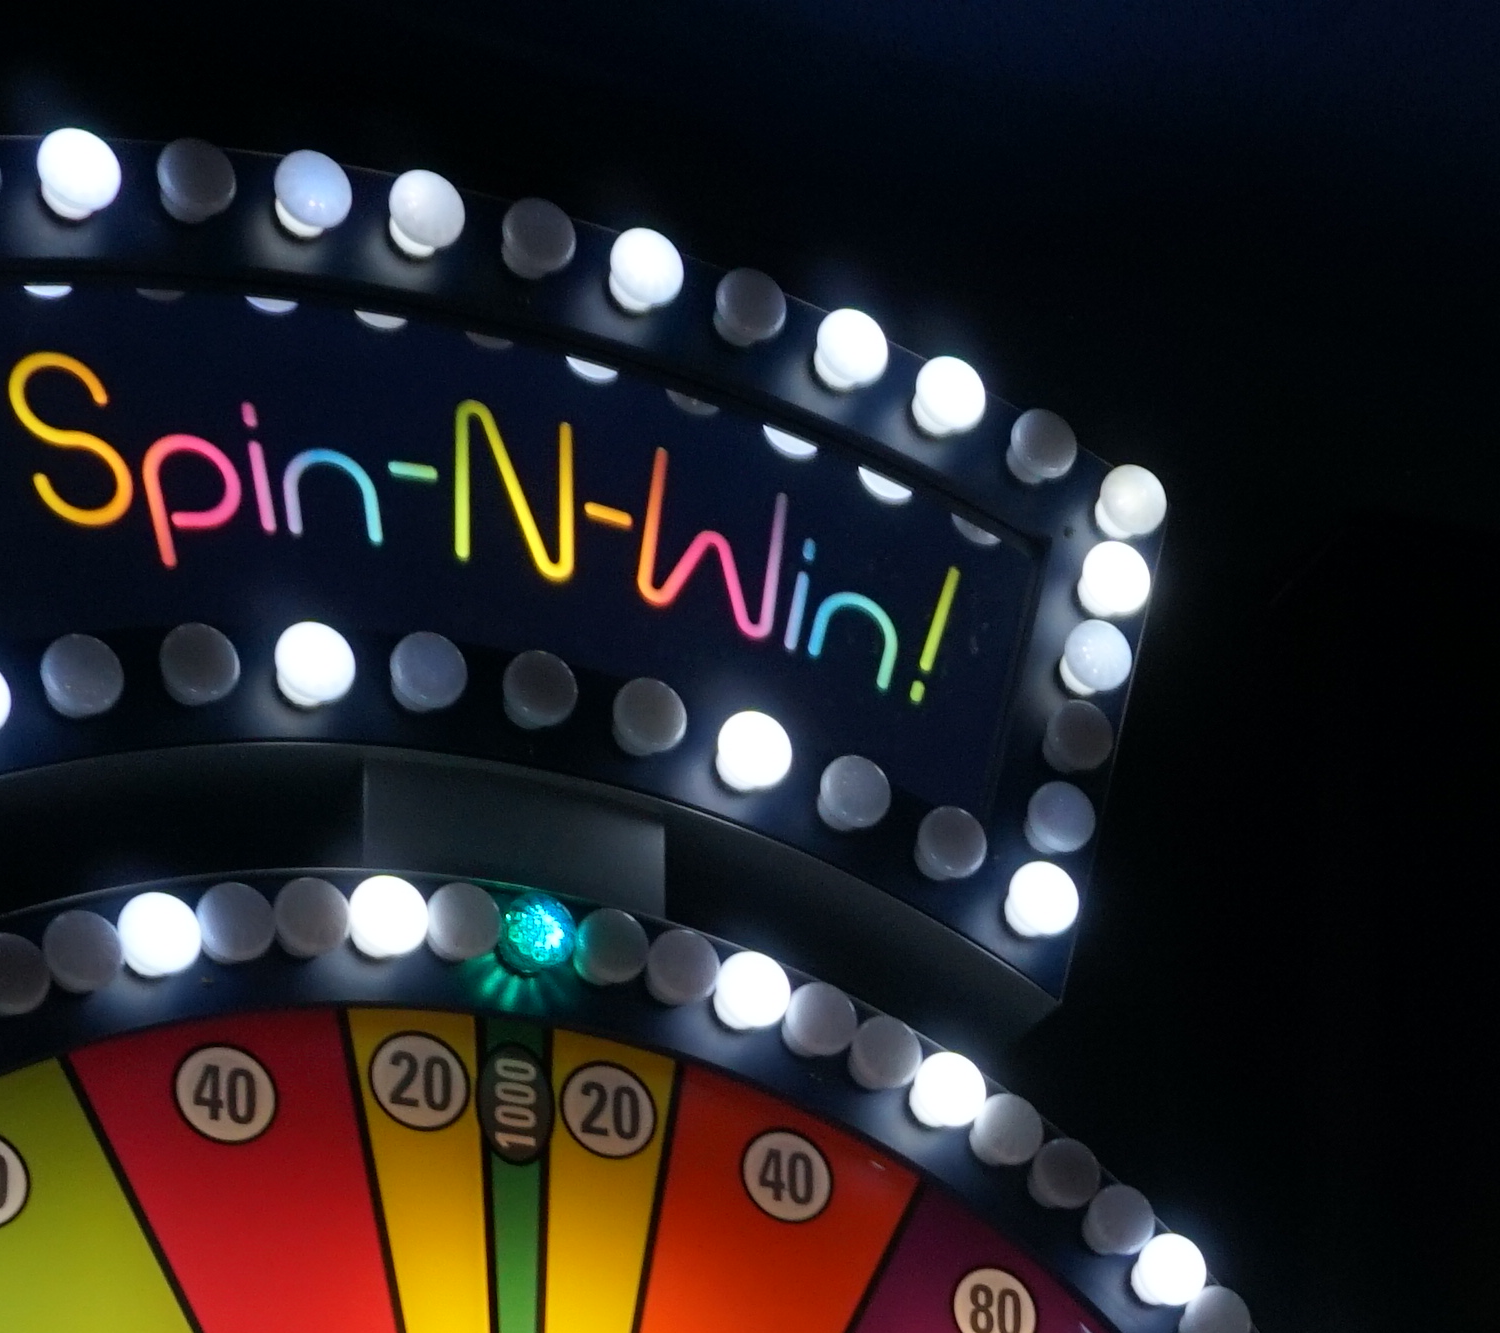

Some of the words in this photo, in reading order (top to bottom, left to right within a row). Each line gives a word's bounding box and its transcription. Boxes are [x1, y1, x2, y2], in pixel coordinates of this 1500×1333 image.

[9, 351, 960, 702] Spin-N-Win!
[194, 1063, 256, 1123] 40
[389, 1052, 455, 1110] 20
[494, 1057, 538, 1151] 1000
[579, 1081, 640, 1140] 20
[758, 1149, 814, 1204] 40
